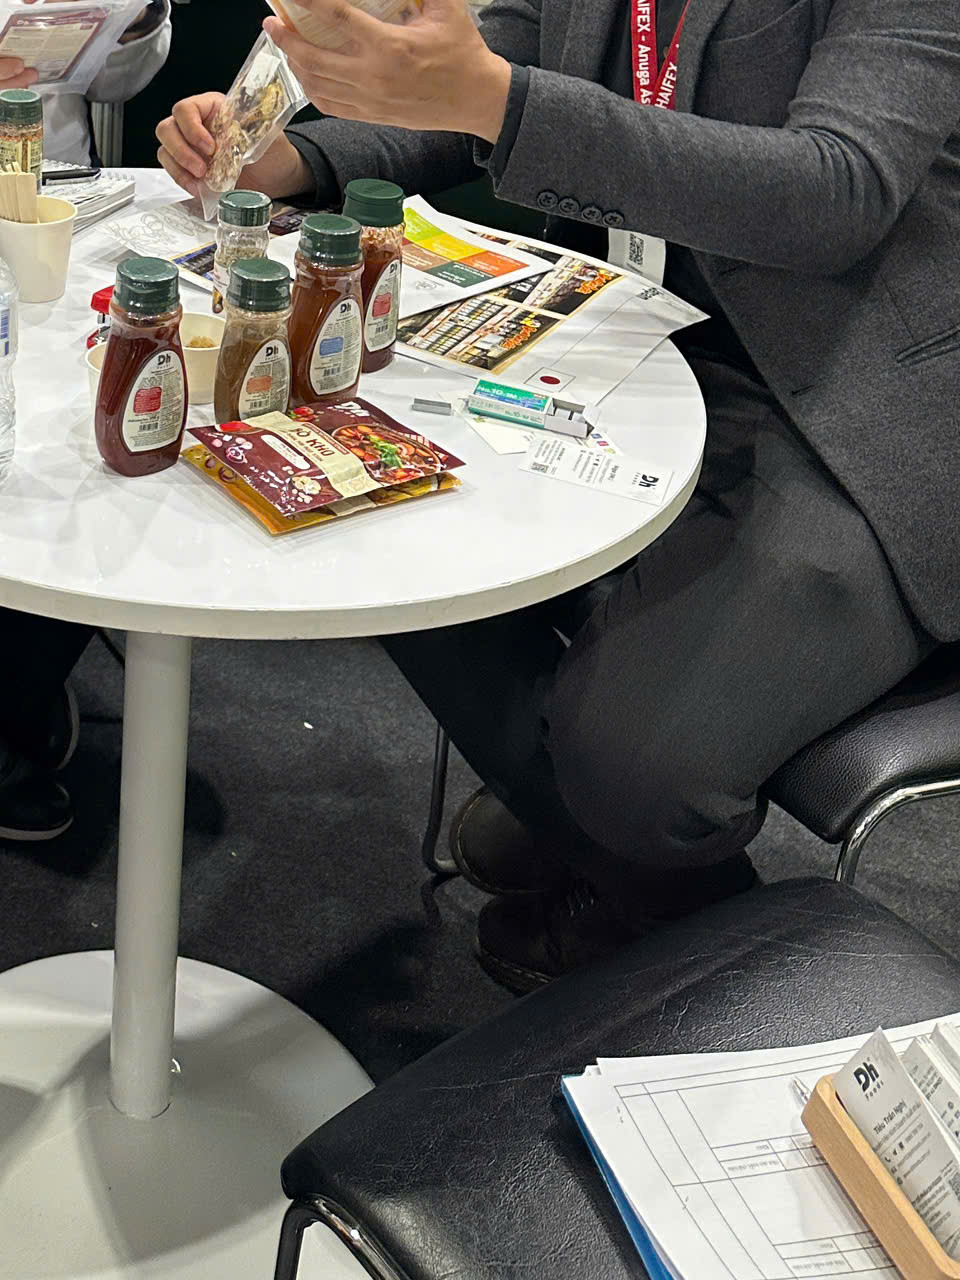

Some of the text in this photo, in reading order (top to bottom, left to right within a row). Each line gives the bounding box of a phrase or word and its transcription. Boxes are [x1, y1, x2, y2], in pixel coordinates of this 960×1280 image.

[635, 44, 651, 86] Anuga
[654, 63, 678, 109] HAIFEX
[340, 304, 351, 313] Dh
[158, 354, 171, 365] Dh
[266, 345, 278, 357] Dh
[307, 438, 335, 455] KHO
[853, 1061, 880, 1092] Dh
